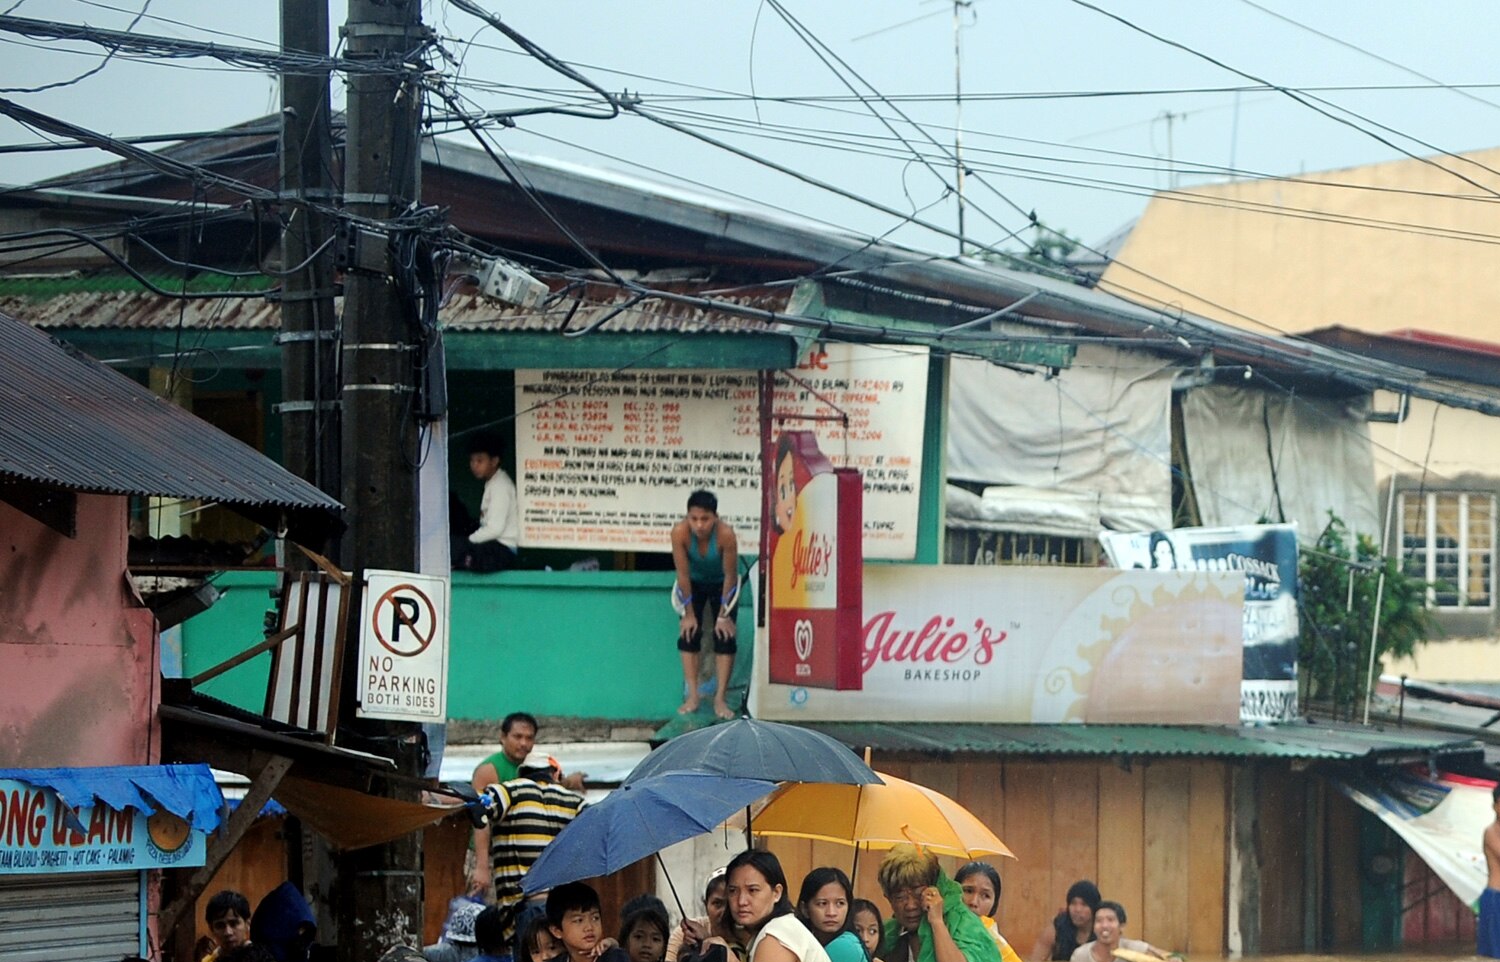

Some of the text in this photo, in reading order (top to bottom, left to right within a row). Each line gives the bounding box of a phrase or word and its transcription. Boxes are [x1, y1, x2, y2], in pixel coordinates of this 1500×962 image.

[862, 611, 1007, 675] Julie's
[369, 655, 393, 673] NO
[904, 669, 981, 681] BAKESHOP
[368, 674, 436, 695] PARKING
[367, 692, 435, 709] BOTH SIDES
[73, 850, 85, 866] HOT
[86, 848, 102, 864] CAKE
